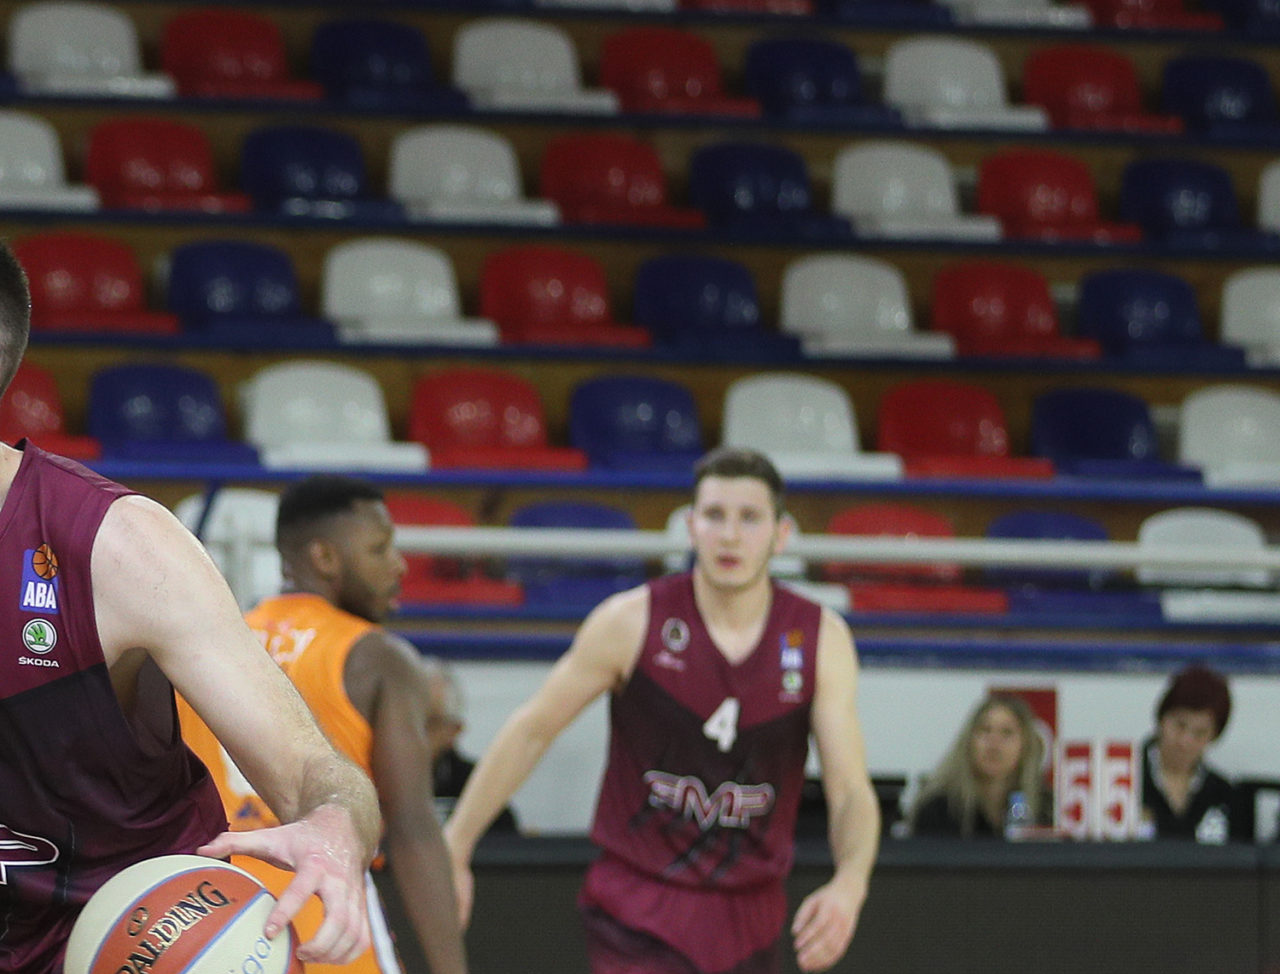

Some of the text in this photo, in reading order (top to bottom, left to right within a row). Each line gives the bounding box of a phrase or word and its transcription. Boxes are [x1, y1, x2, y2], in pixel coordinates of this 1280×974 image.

[22, 581, 58, 610] ABA
[18, 655, 60, 668] ŠKODA
[702, 697, 740, 752] 4
[643, 769, 776, 831] FMP
